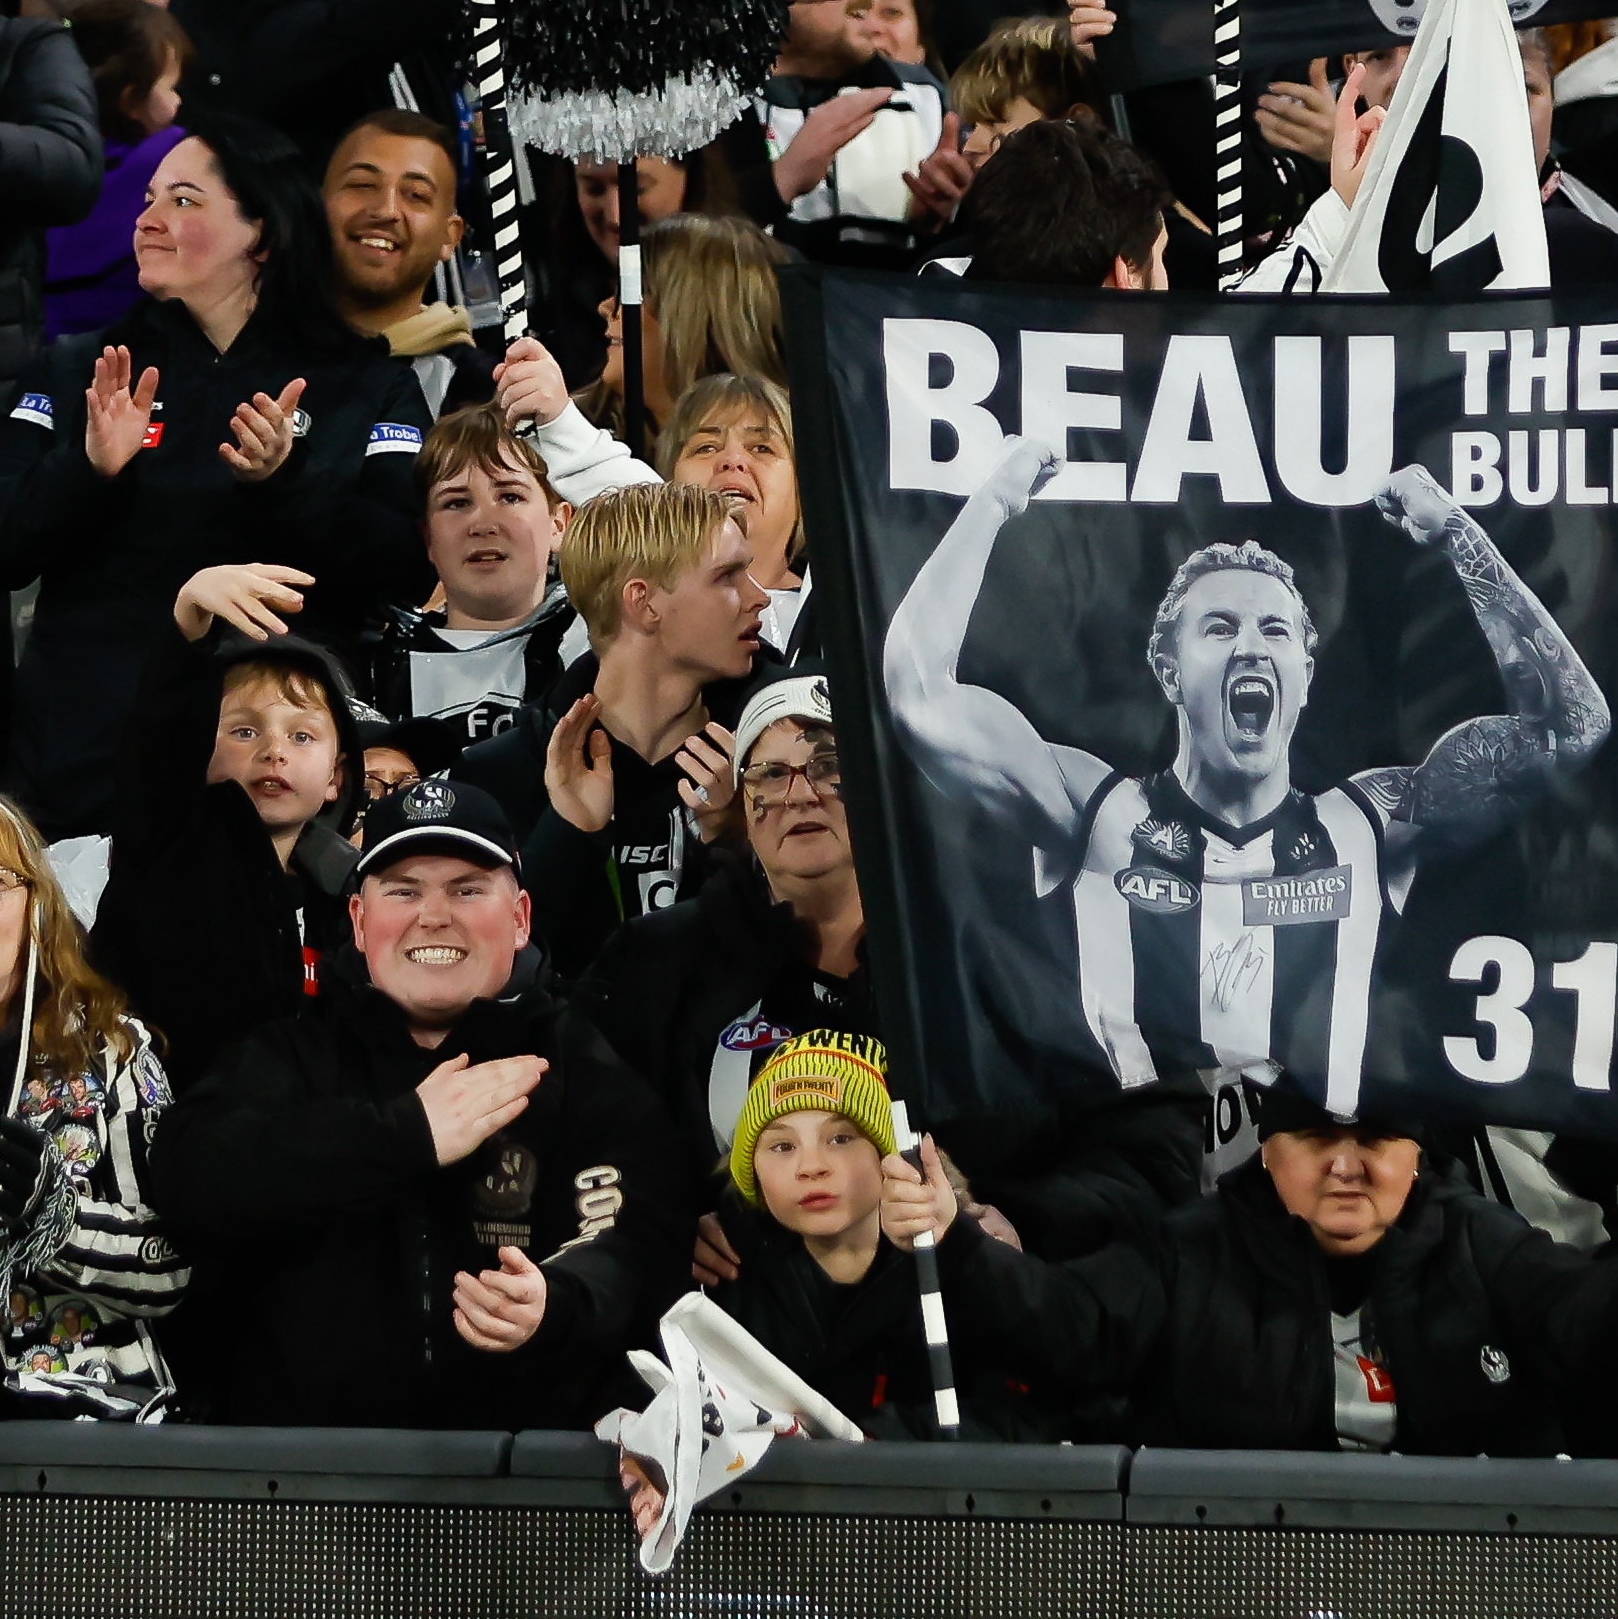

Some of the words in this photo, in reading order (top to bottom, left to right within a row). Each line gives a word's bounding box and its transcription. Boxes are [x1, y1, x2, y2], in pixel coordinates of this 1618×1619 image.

[881, 317, 1396, 506] BEAU
[380, 426, 419, 442] Trobe
[620, 844, 669, 864] ISC
[1120, 875, 1192, 905] AFL
[1250, 873, 1347, 900] Emirates
[1266, 898, 1290, 917] FLY
[1292, 895, 1334, 915] BETTER
[726, 1020, 792, 1046] AFL
